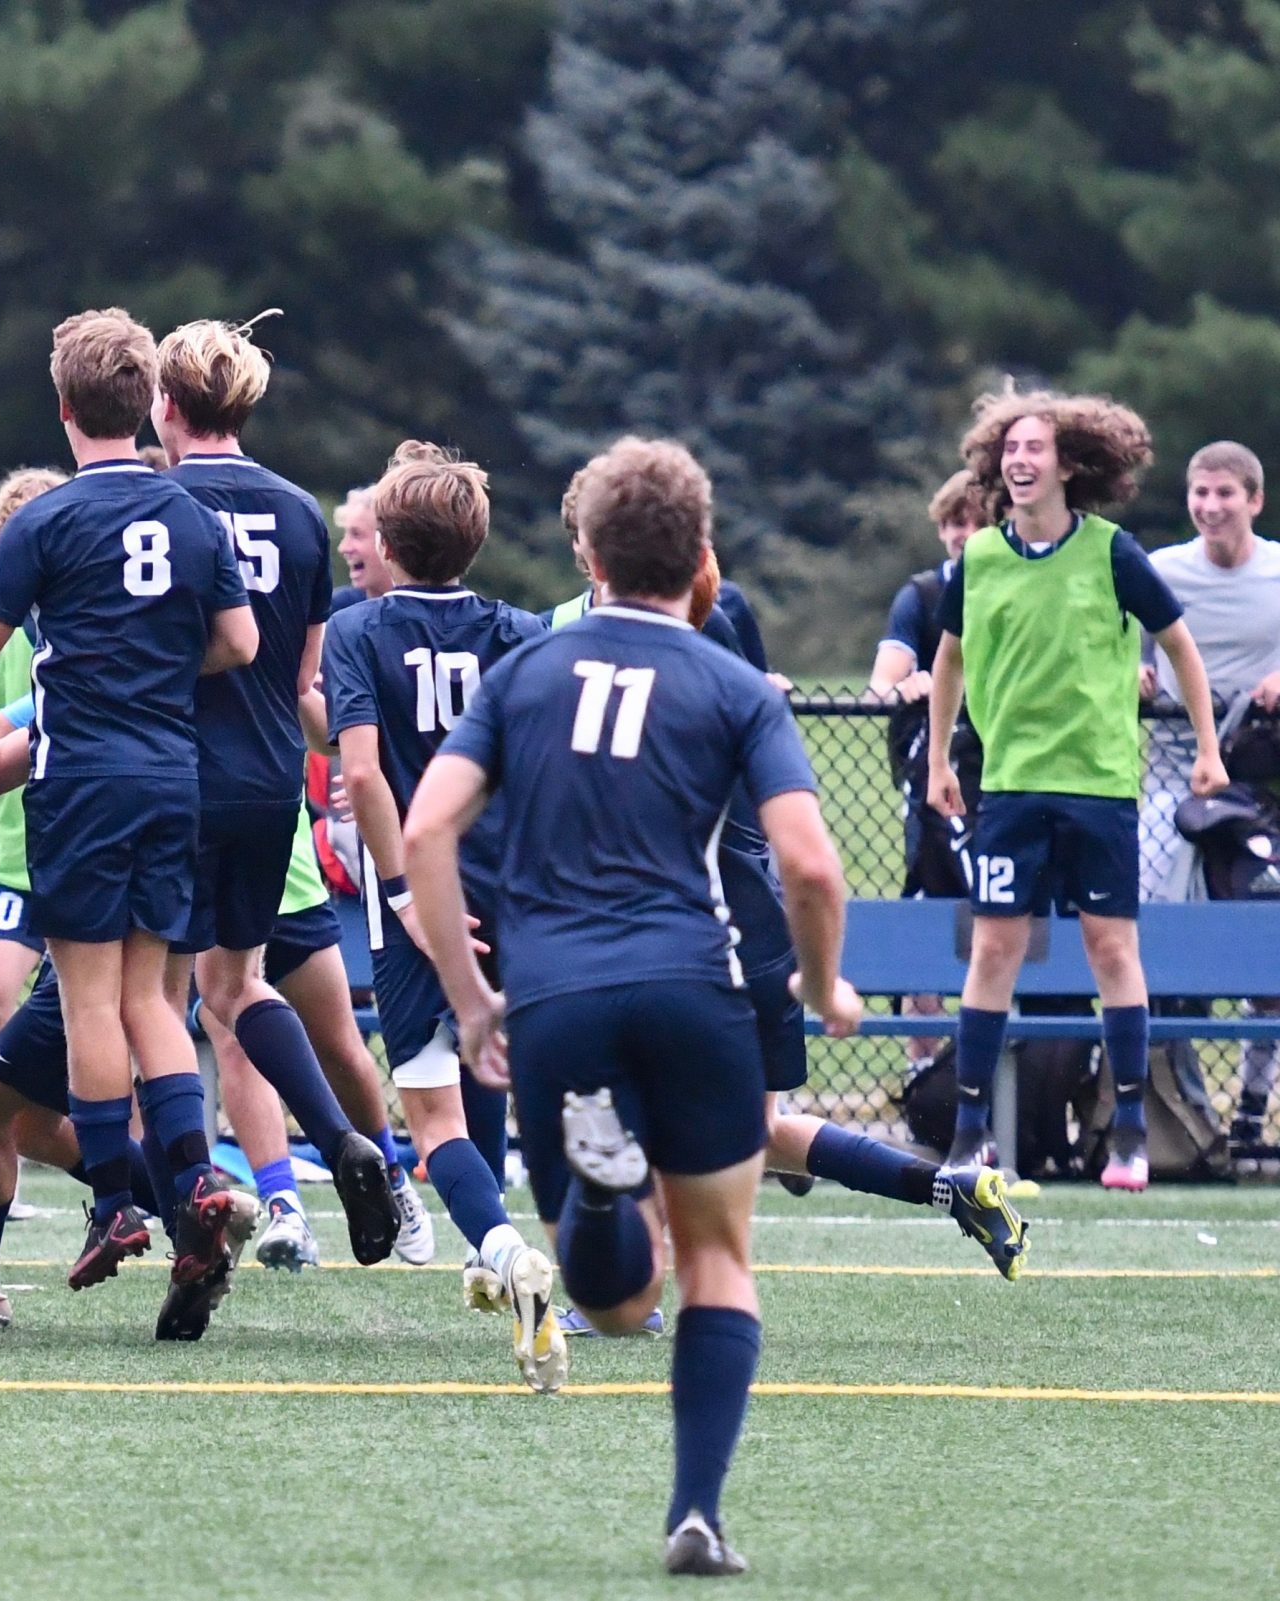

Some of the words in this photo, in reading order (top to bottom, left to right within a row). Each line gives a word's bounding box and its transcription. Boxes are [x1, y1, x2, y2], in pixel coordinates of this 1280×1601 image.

[122, 520, 172, 596] 8
[403, 647, 481, 732] 10
[571, 660, 656, 759] 11
[977, 856, 1015, 903] 12
